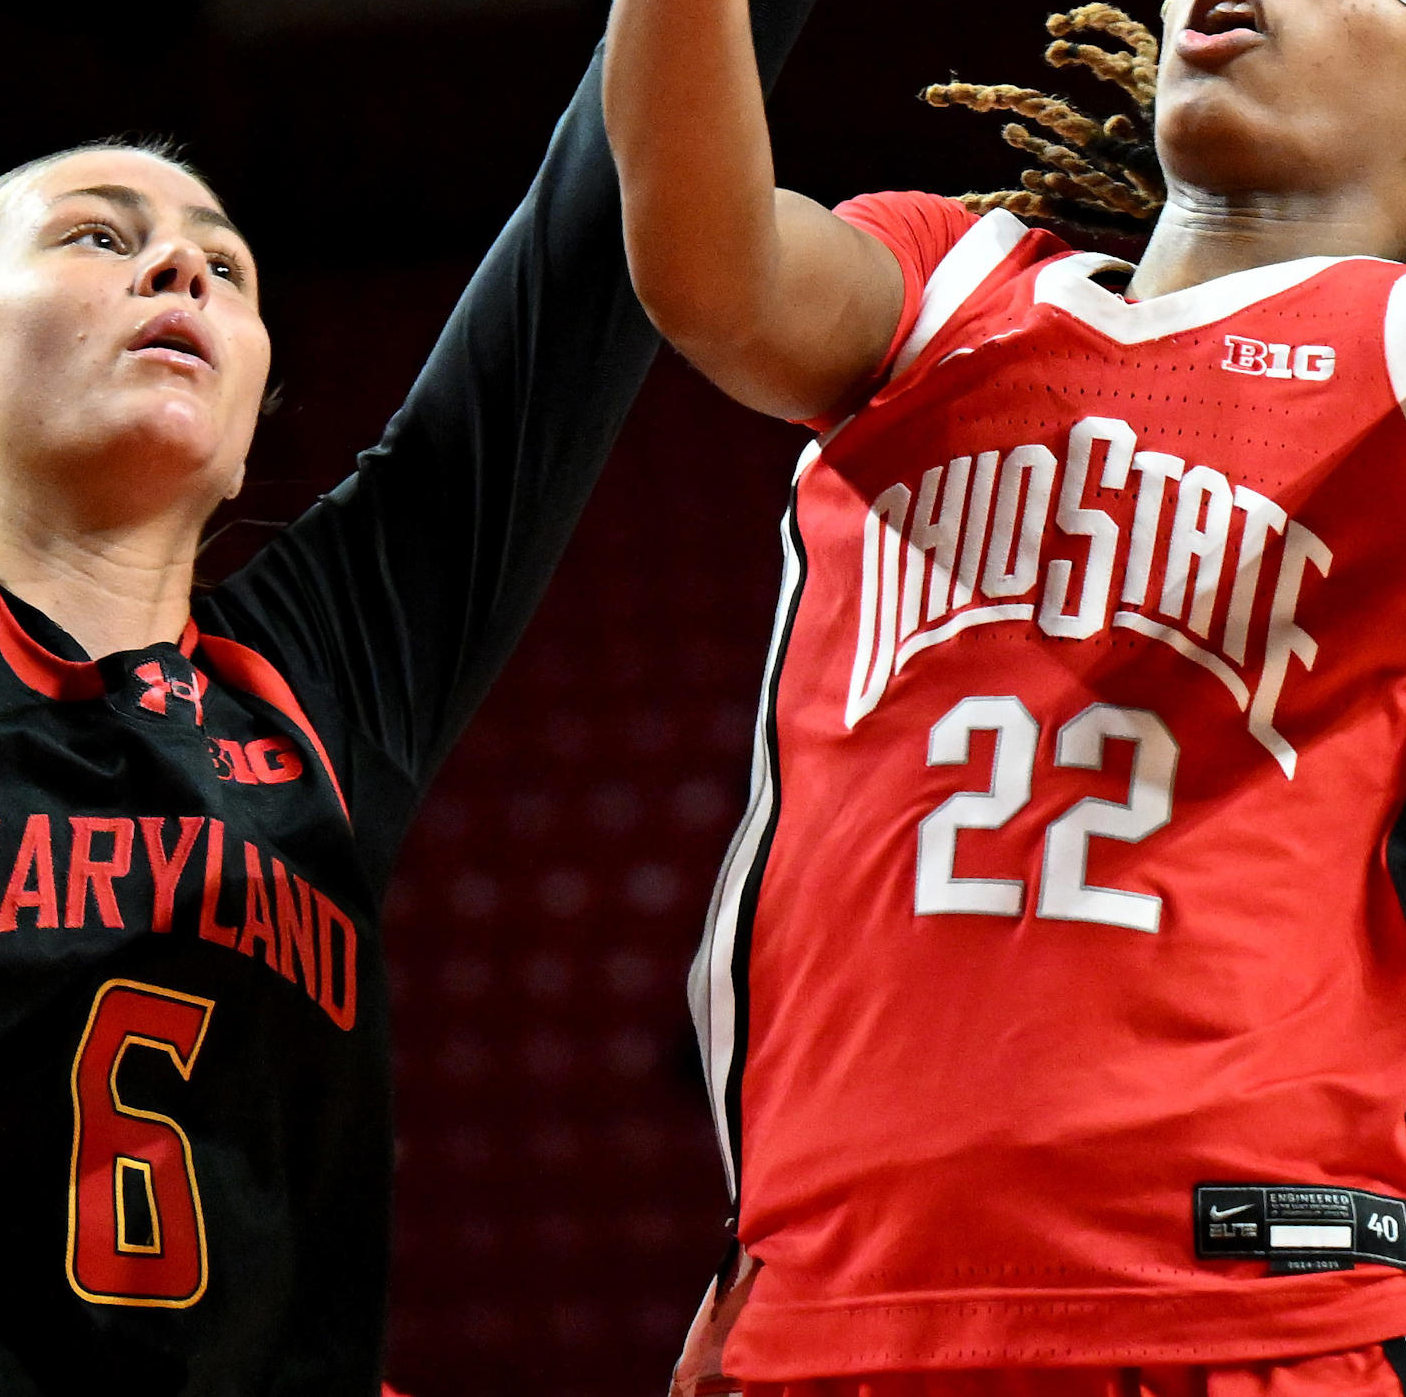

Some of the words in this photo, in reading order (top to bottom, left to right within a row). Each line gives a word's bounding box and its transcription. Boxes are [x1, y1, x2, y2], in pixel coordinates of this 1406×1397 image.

[914, 695, 1180, 933] 22
[65, 977, 215, 1308] 6
[1270, 1193, 1349, 1204] ENGINEERED
[1367, 1212, 1399, 1243] 40
